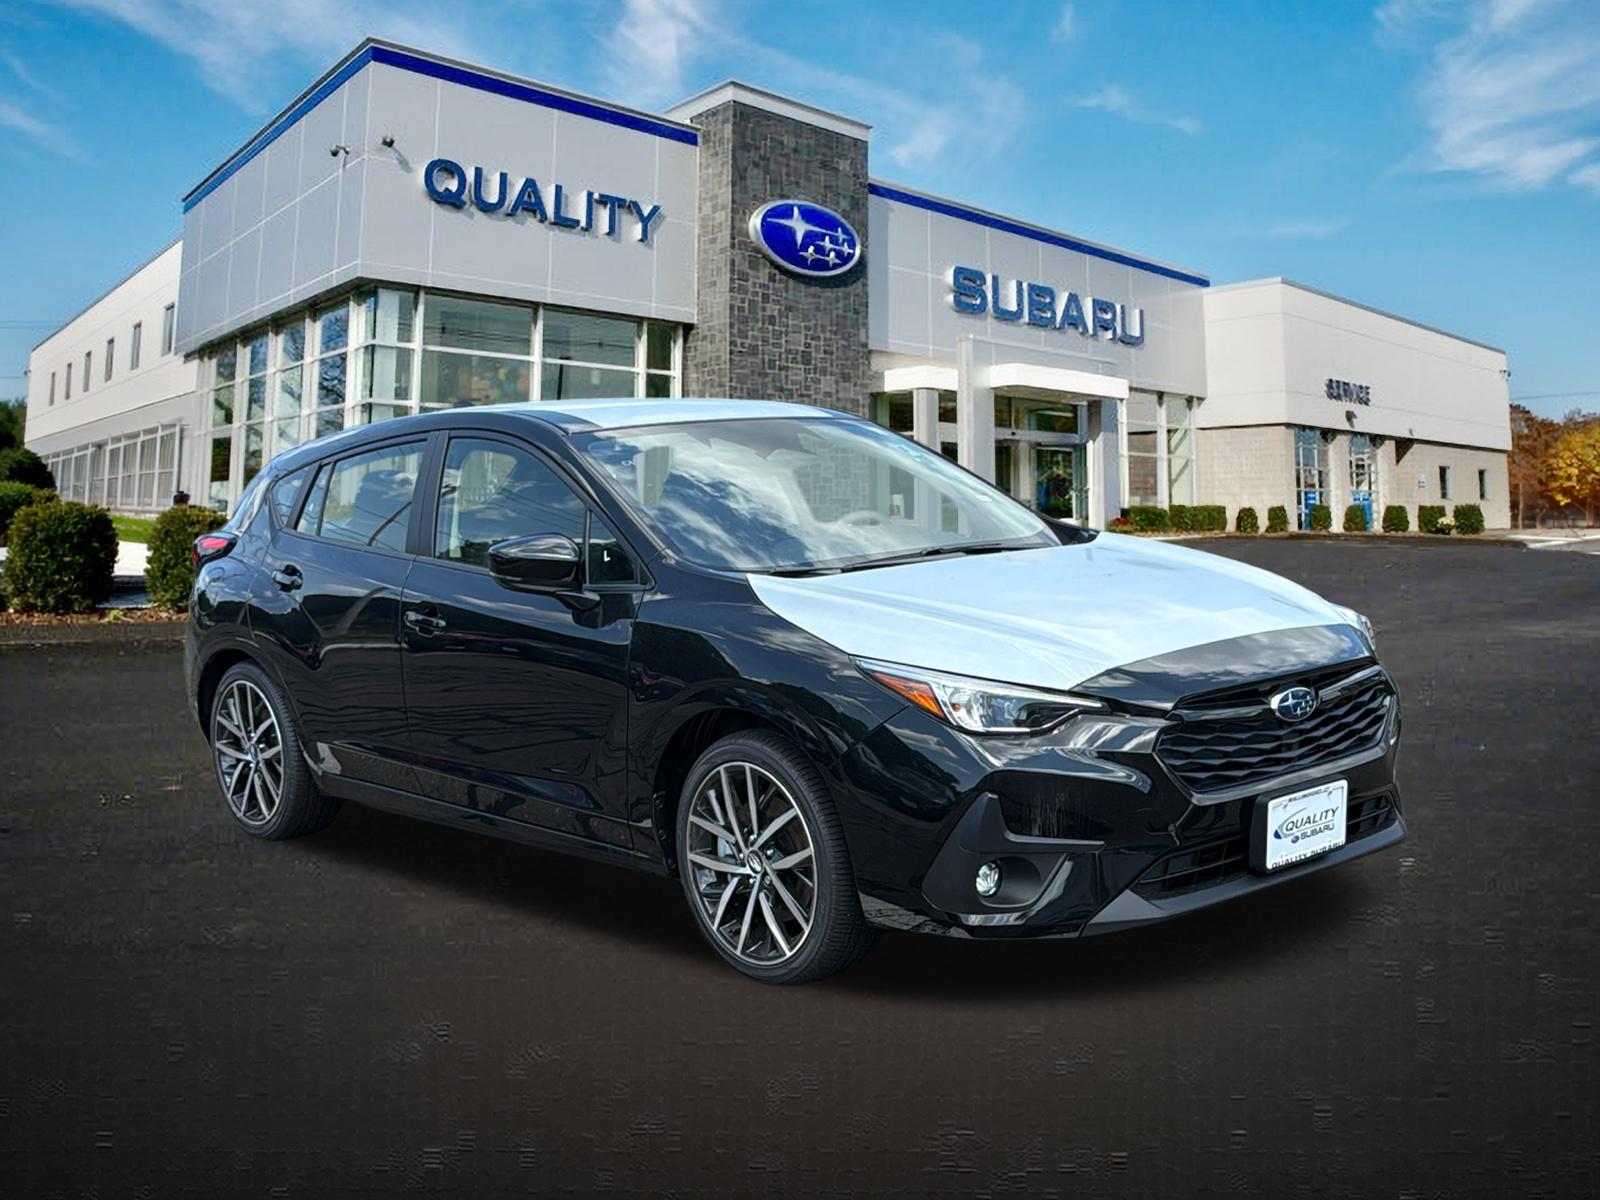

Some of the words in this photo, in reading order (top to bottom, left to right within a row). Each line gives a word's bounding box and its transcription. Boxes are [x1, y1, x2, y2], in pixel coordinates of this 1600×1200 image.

[424, 158, 661, 242] QUALITY
[949, 265, 1145, 346] SUBARU
[1285, 806, 1339, 832] QUALITY
[1300, 823, 1335, 840] SUBARU
